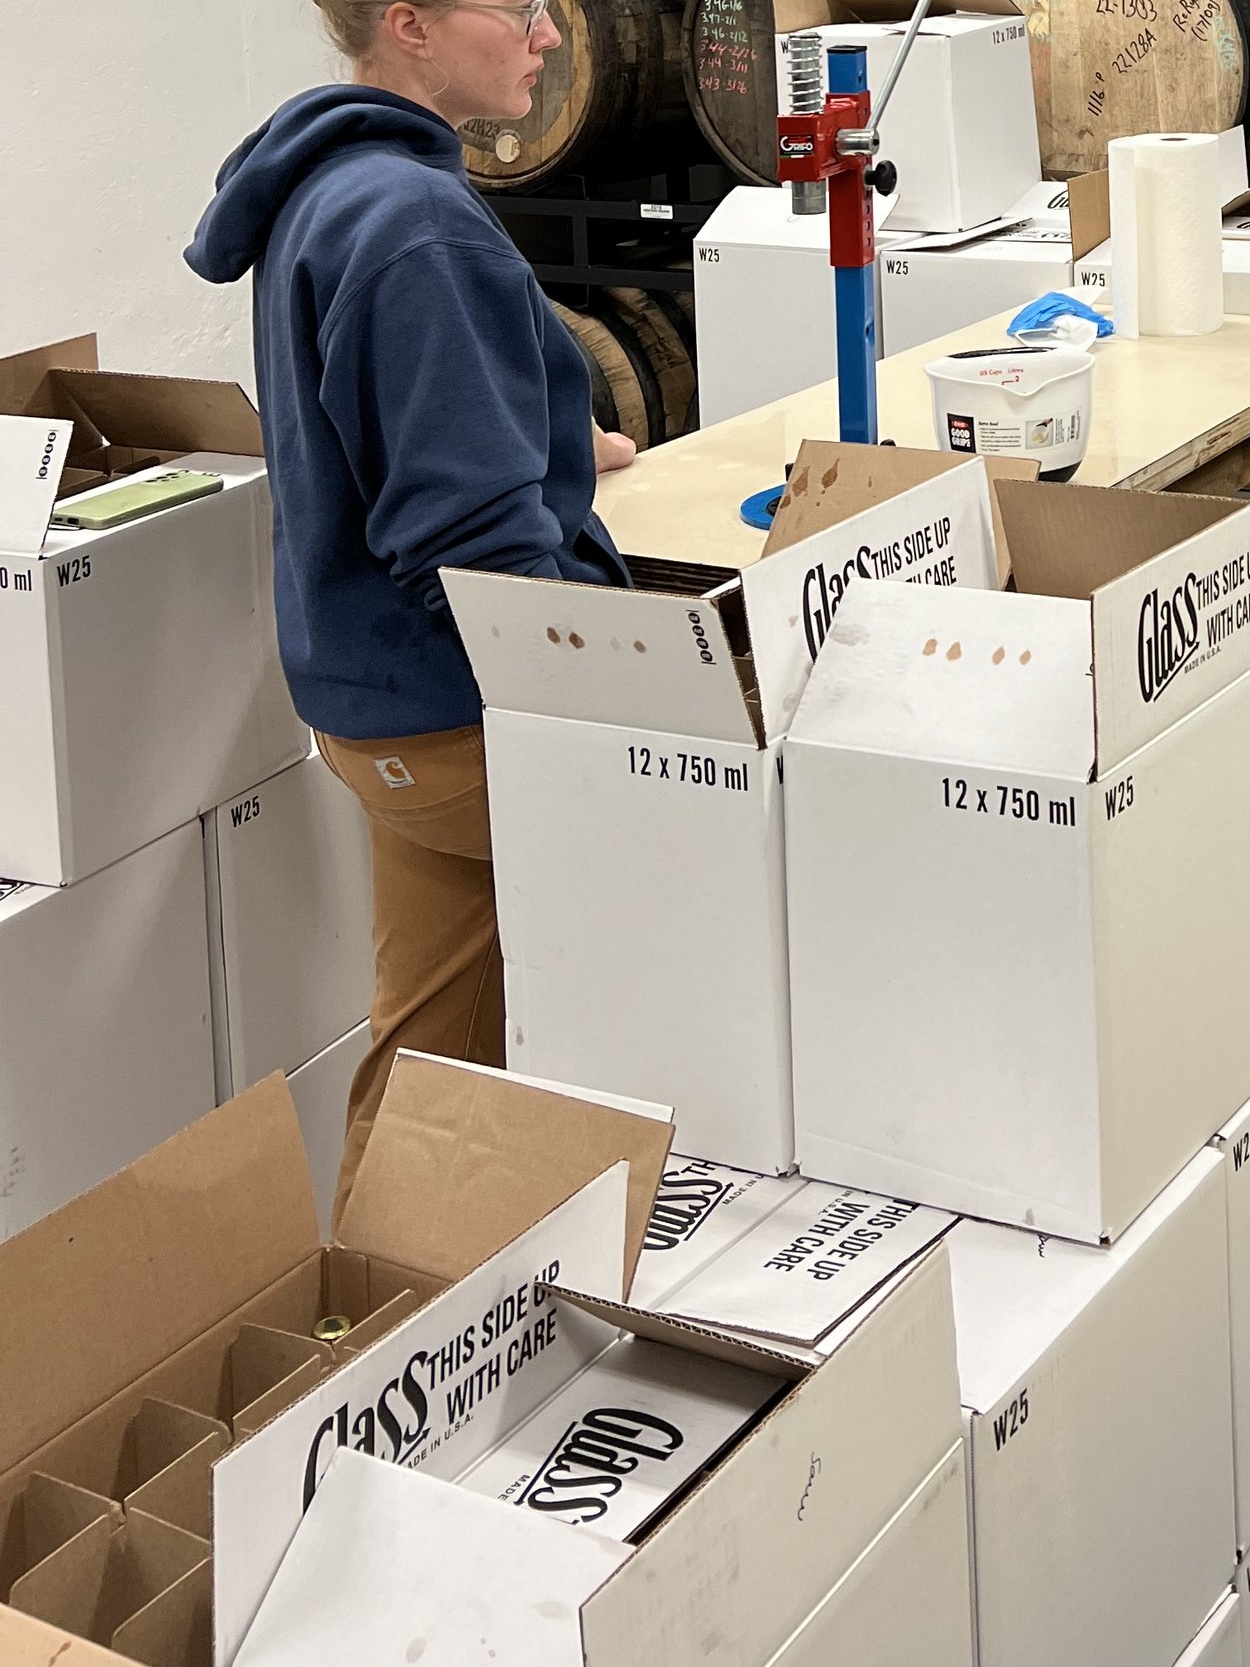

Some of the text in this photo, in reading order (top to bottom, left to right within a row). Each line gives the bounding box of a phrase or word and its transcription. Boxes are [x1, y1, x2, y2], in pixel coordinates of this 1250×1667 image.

[1111, 28, 1157, 74] 22128A
[699, 247, 720, 263] W25
[886, 260, 909, 276] W25
[1081, 271, 1106, 287] W25
[57, 555, 91, 588] W25
[871, 516, 951, 580] THIS SIDE UP
[14, 569, 32, 592] ml
[1195, 570, 1220, 610] THIS
[1222, 555, 1245, 595] SIDE
[1137, 572, 1198, 704] Glass
[1206, 604, 1234, 648] WITH
[628, 746, 652, 777] 12
[659, 756, 670, 780] x
[676, 753, 716, 786] 750
[724, 762, 749, 792] ml
[231, 795, 261, 828] W25
[942, 777, 1076, 827] 12 x 750 ml
[1104, 774, 1134, 822] W25
[722, 1185, 749, 1206] MADE
[763, 1200, 871, 1273] WITH CARE
[806, 1198, 921, 1281] THIS SIDE UP
[426, 1324, 476, 1390] THIS
[481, 1283, 529, 1349] SIDE
[446, 1307, 558, 1425] WITH CARE
[407, 1416, 474, 1469] ADE IN U.S.A.
[993, 1387, 1030, 1453] W25
[527, 1407, 685, 1524] Glass
